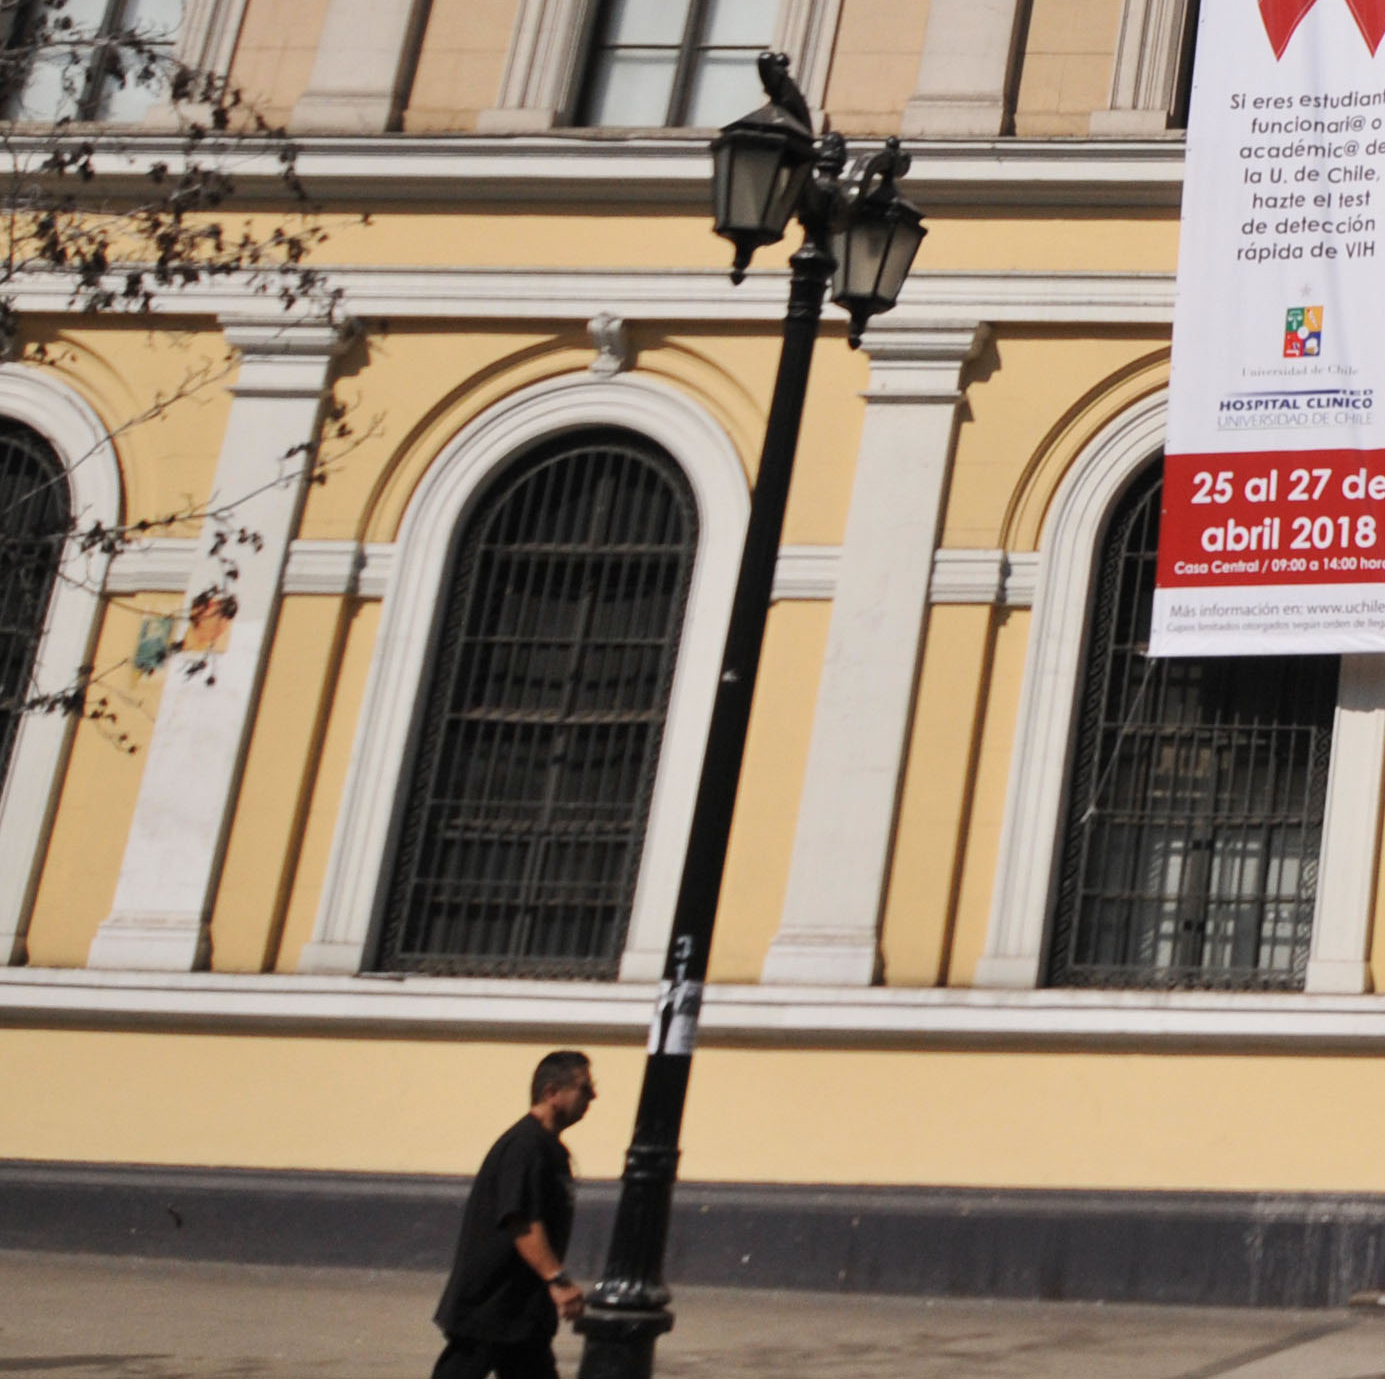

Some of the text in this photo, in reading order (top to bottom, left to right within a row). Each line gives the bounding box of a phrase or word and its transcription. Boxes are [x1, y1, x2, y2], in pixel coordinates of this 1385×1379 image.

[1230, 93, 1246, 110] Si
[1252, 95, 1294, 110] eres
[1251, 115, 1382, 134] funcionari@ o
[1239, 138, 1360, 159] académic@
[1244, 165, 1380, 184] la U. de Chile,
[1252, 190, 1371, 209] hazte el test
[1241, 214, 1376, 235] de detección
[1237, 241, 1376, 264] rápida de VIH
[1219, 396, 1373, 412] HOSPITAL CLINICO
[1216, 412, 1372, 428] UNIVERSIDAD DE CHILE
[1191, 471, 1235, 504] 25
[1244, 469, 1278, 502] al
[1287, 468, 1332, 501] 27
[1201, 515, 1377, 552] abril 2018
[1174, 560, 1208, 575] Casa
[1211, 558, 1259, 574] Central
[1271, 558, 1307, 572] 09:00
[1309, 561, 1319, 571] a
[1323, 557, 1358, 571] 14:00
[1170, 603, 1196, 618] Más
[1200, 601, 1279, 617] información
